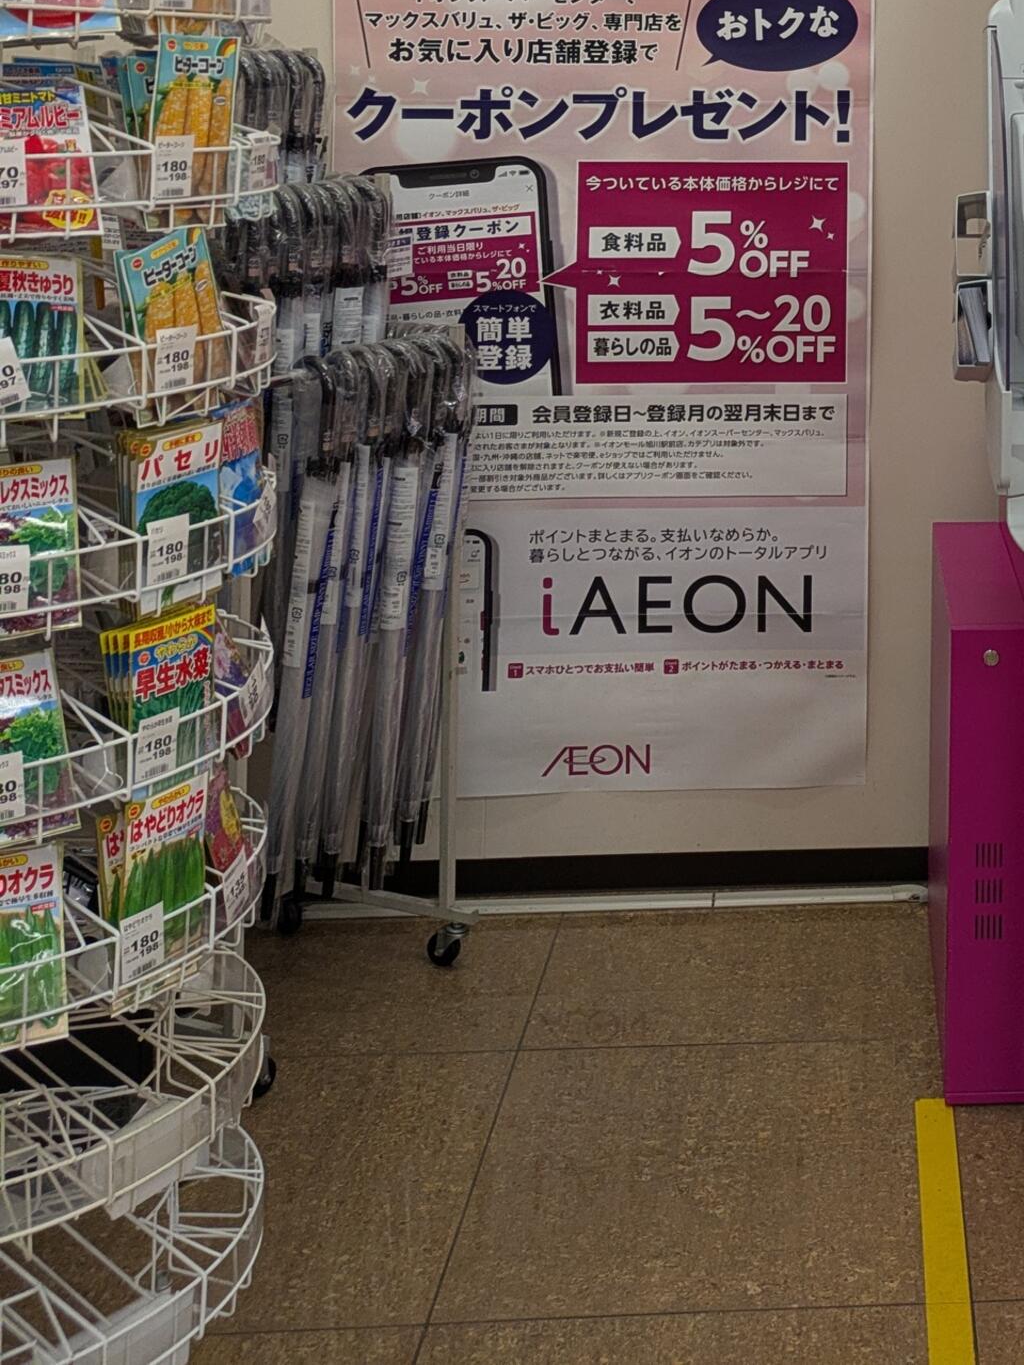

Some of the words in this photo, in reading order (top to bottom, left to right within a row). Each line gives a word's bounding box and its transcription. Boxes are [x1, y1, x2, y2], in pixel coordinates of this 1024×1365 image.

[364, 11, 682, 31] マックスバリュ、ザ・ビッグ、専門店を
[716, 5, 840, 41] おトクな
[388, 38, 658, 64] お気に入り店舗登録で
[346, 85, 852, 143] クーポンプレゼント!
[162, 160, 188, 172] 180
[168, 172, 187, 181] 198
[585, 176, 840, 192] 今ついている本体価格からレジにて
[601, 232, 667, 252] 食料品
[739, 250, 810, 278] OFF
[599, 301, 666, 320] 衣料品
[476, 316, 533, 342] 簡単
[593, 337, 672, 357] 暮らしの品
[163, 350, 190, 365] 180
[170, 362, 190, 372] 198
[476, 344, 533, 371] 登録
[140, 438, 220, 482] パセリ
[529, 527, 779, 544] ポイントまとまる。支払いなめらか。
[157, 540, 184, 557] 180
[529, 545, 828, 563] 暮らしとつながる、イオンのトータルアプリ
[164, 553, 183, 565] 198
[542, 574, 813, 636] iAEON
[136, 646, 210, 701] 早生水菜
[144, 734, 172, 752] 180
[152, 747, 172, 760] 198
[129, 789, 205, 844] はやどりオクラ
[130, 929, 160, 953] 180
